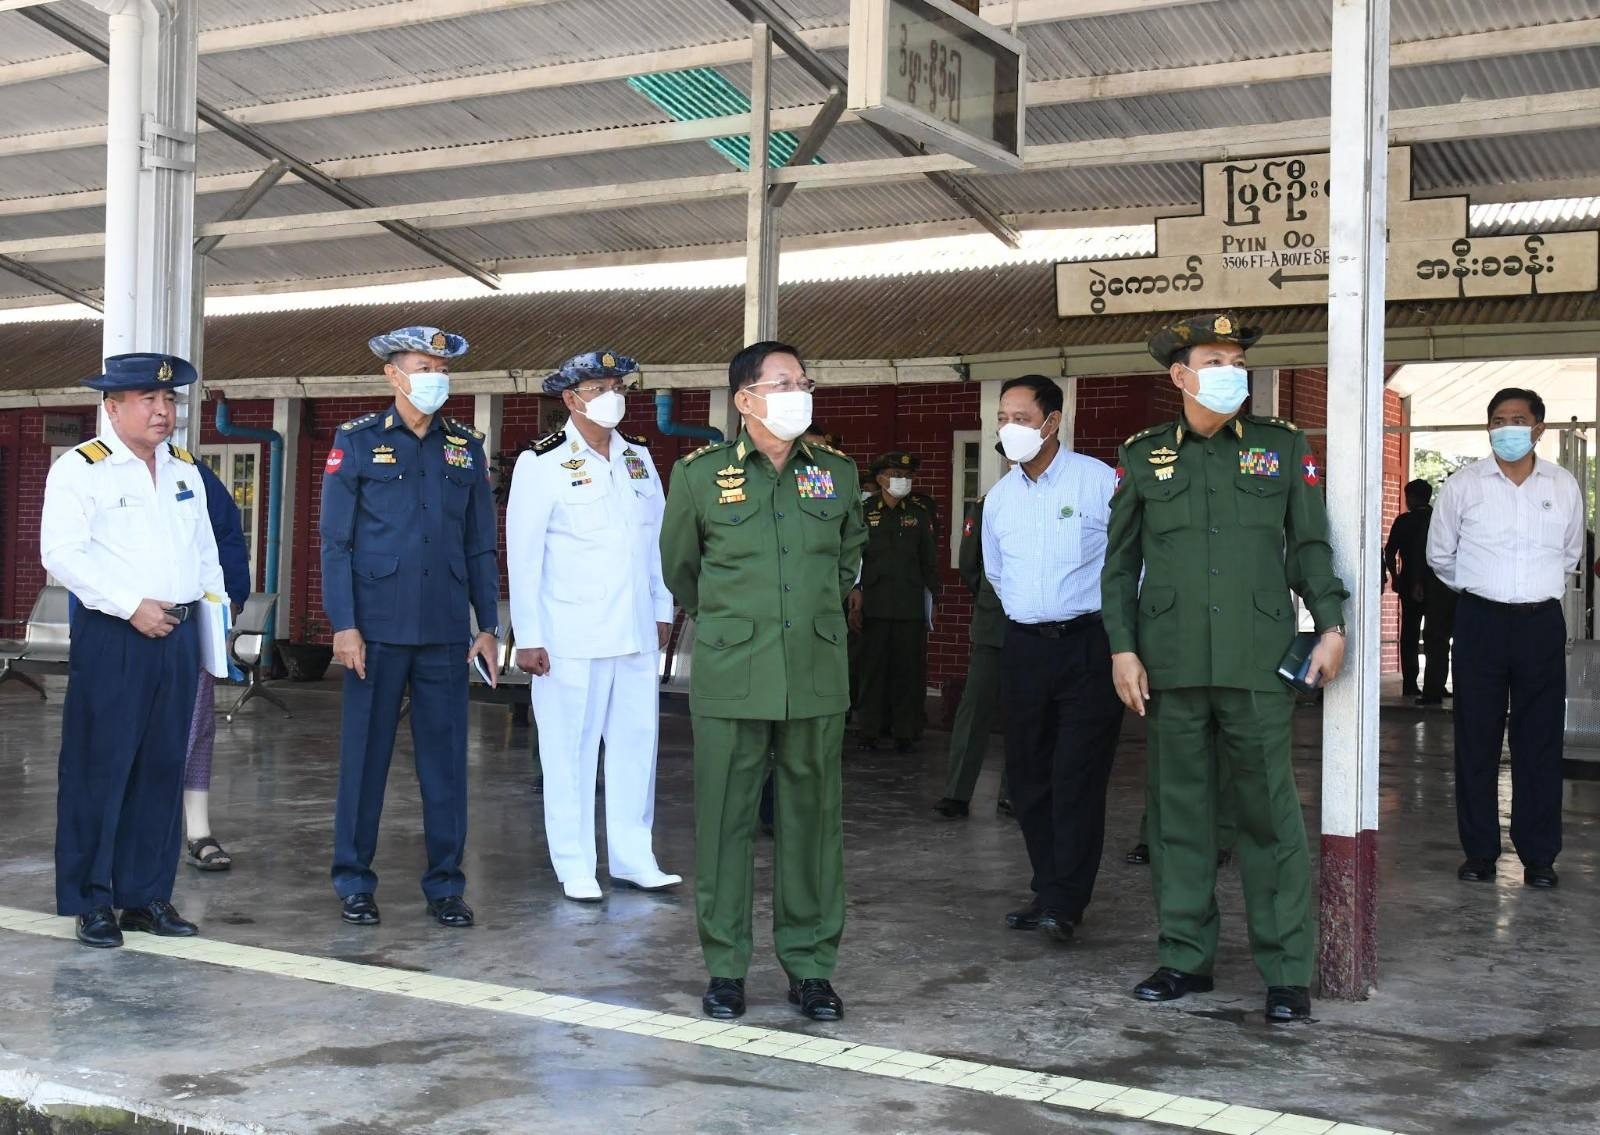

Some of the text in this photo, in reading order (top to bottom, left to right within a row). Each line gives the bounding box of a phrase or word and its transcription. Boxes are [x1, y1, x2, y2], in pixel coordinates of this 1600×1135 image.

[1221, 159, 1330, 227] ပြင်ဦး
[1221, 235, 1267, 253] PYIN
[1222, 256, 1249, 269] 3506
[1313, 249, 1330, 265] SE
